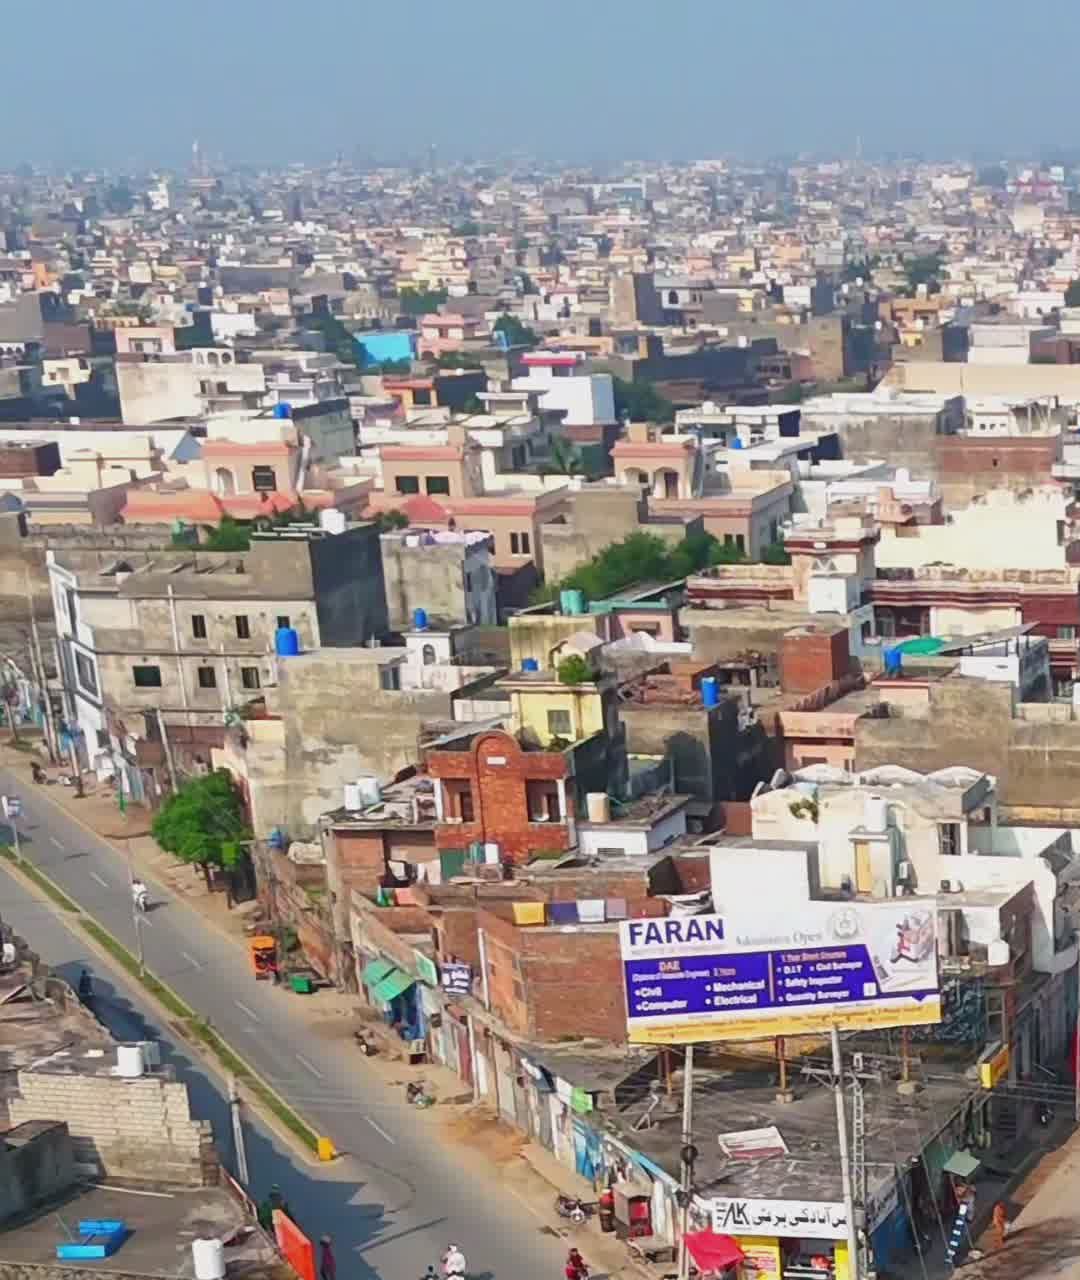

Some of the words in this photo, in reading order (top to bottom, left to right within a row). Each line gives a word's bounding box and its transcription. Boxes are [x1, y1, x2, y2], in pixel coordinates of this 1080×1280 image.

[628, 918, 725, 945] FARAN
[640, 986, 662, 998] Civil
[713, 979, 765, 993] Mechanical
[641, 1000, 688, 1011] Computer
[714, 993, 758, 1006] Electrical
